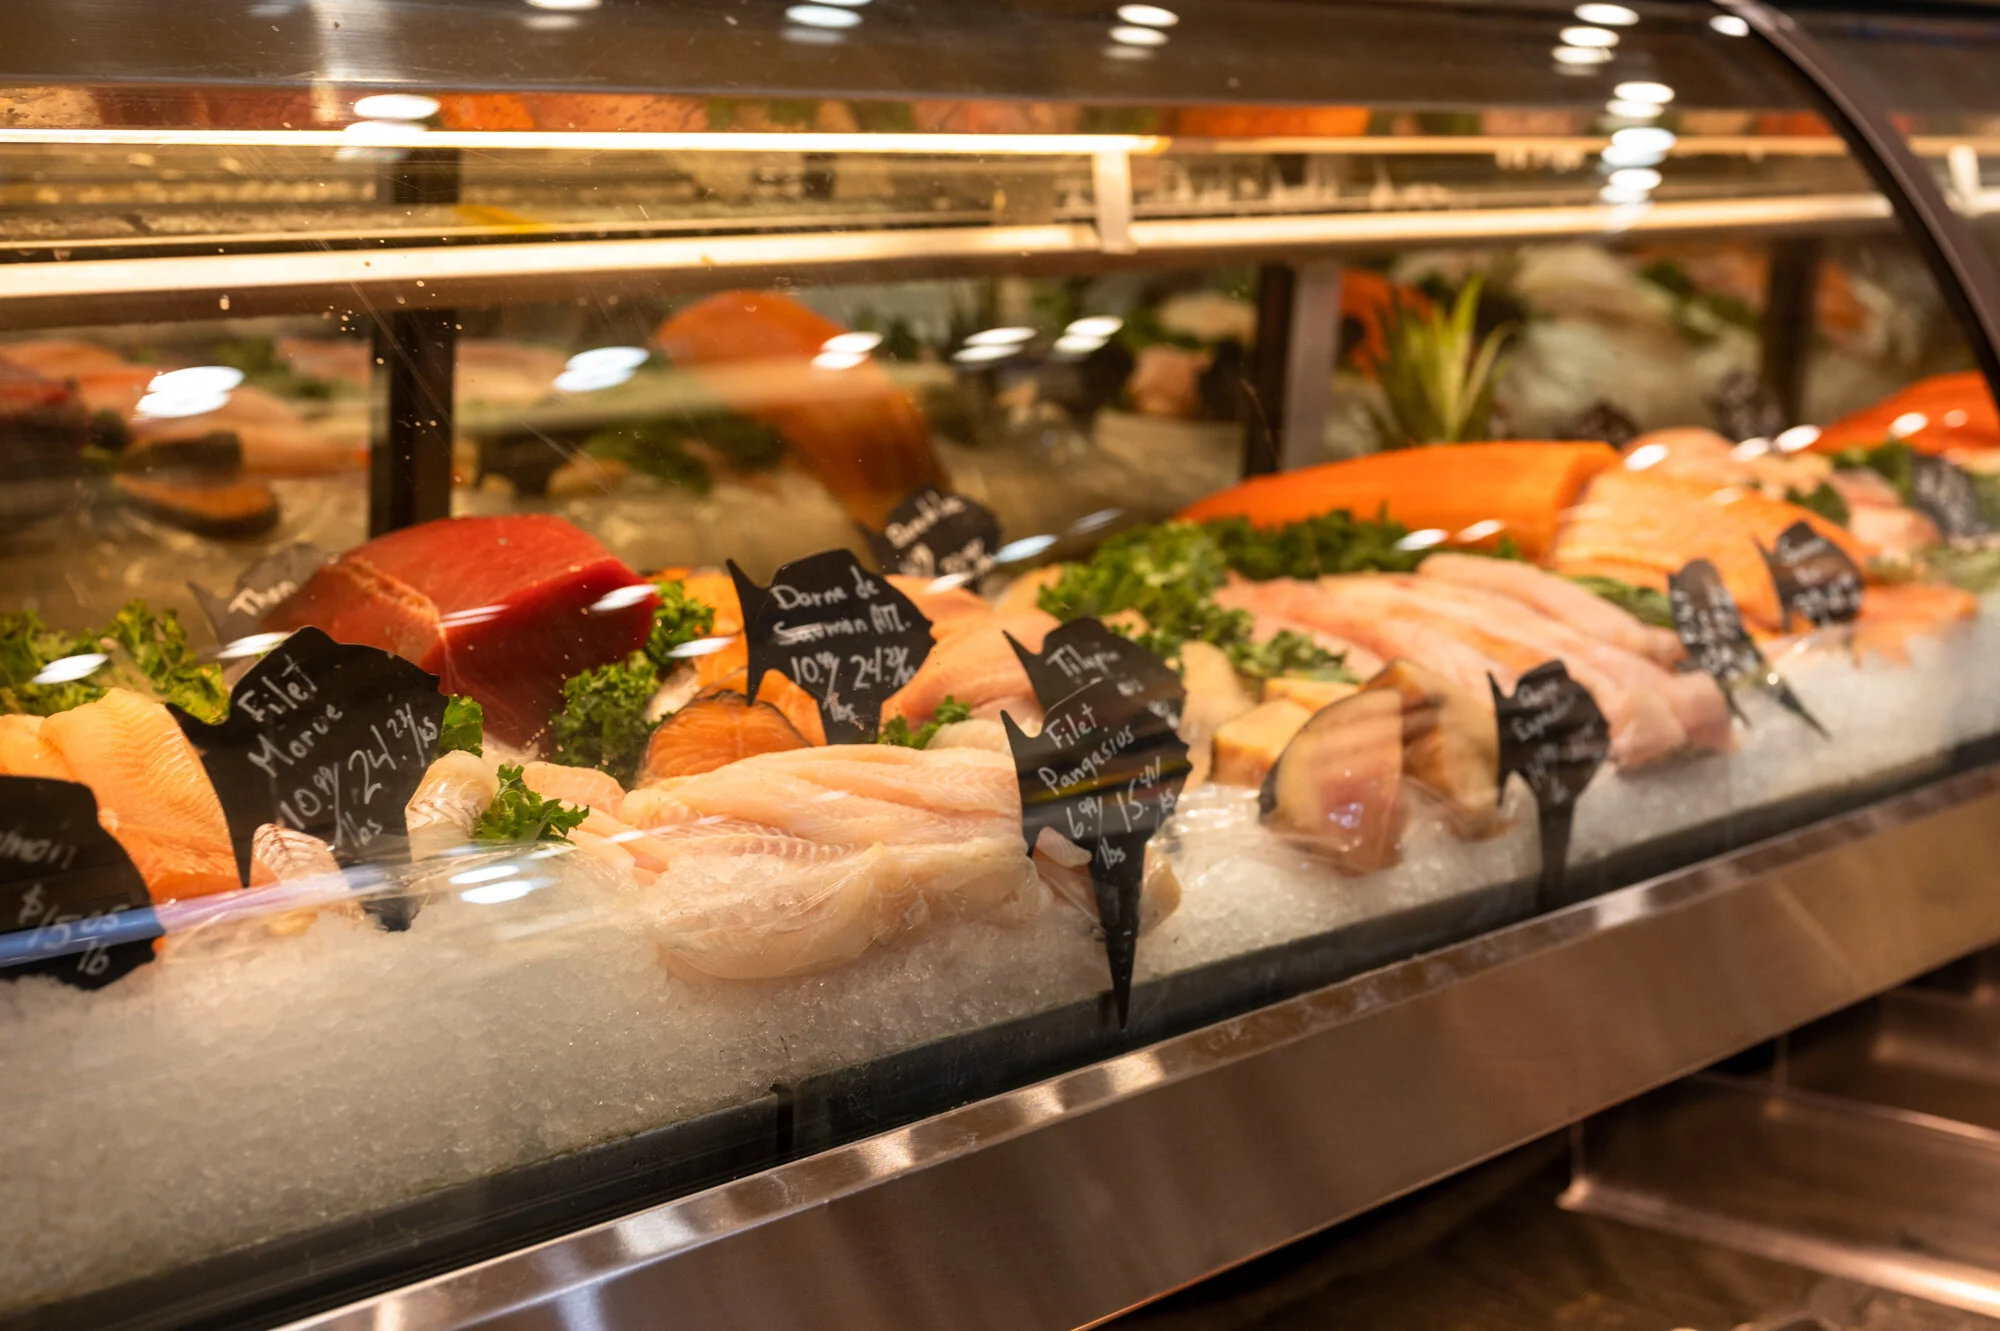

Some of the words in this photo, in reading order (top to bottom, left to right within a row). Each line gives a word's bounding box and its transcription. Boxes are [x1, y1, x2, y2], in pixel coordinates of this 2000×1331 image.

[850, 565, 880, 600] de
[236, 653, 318, 723] Filet
[247, 703, 344, 778] Morue
[1037, 724, 1135, 797] Pangasius
[1044, 702, 1098, 750] Filet
